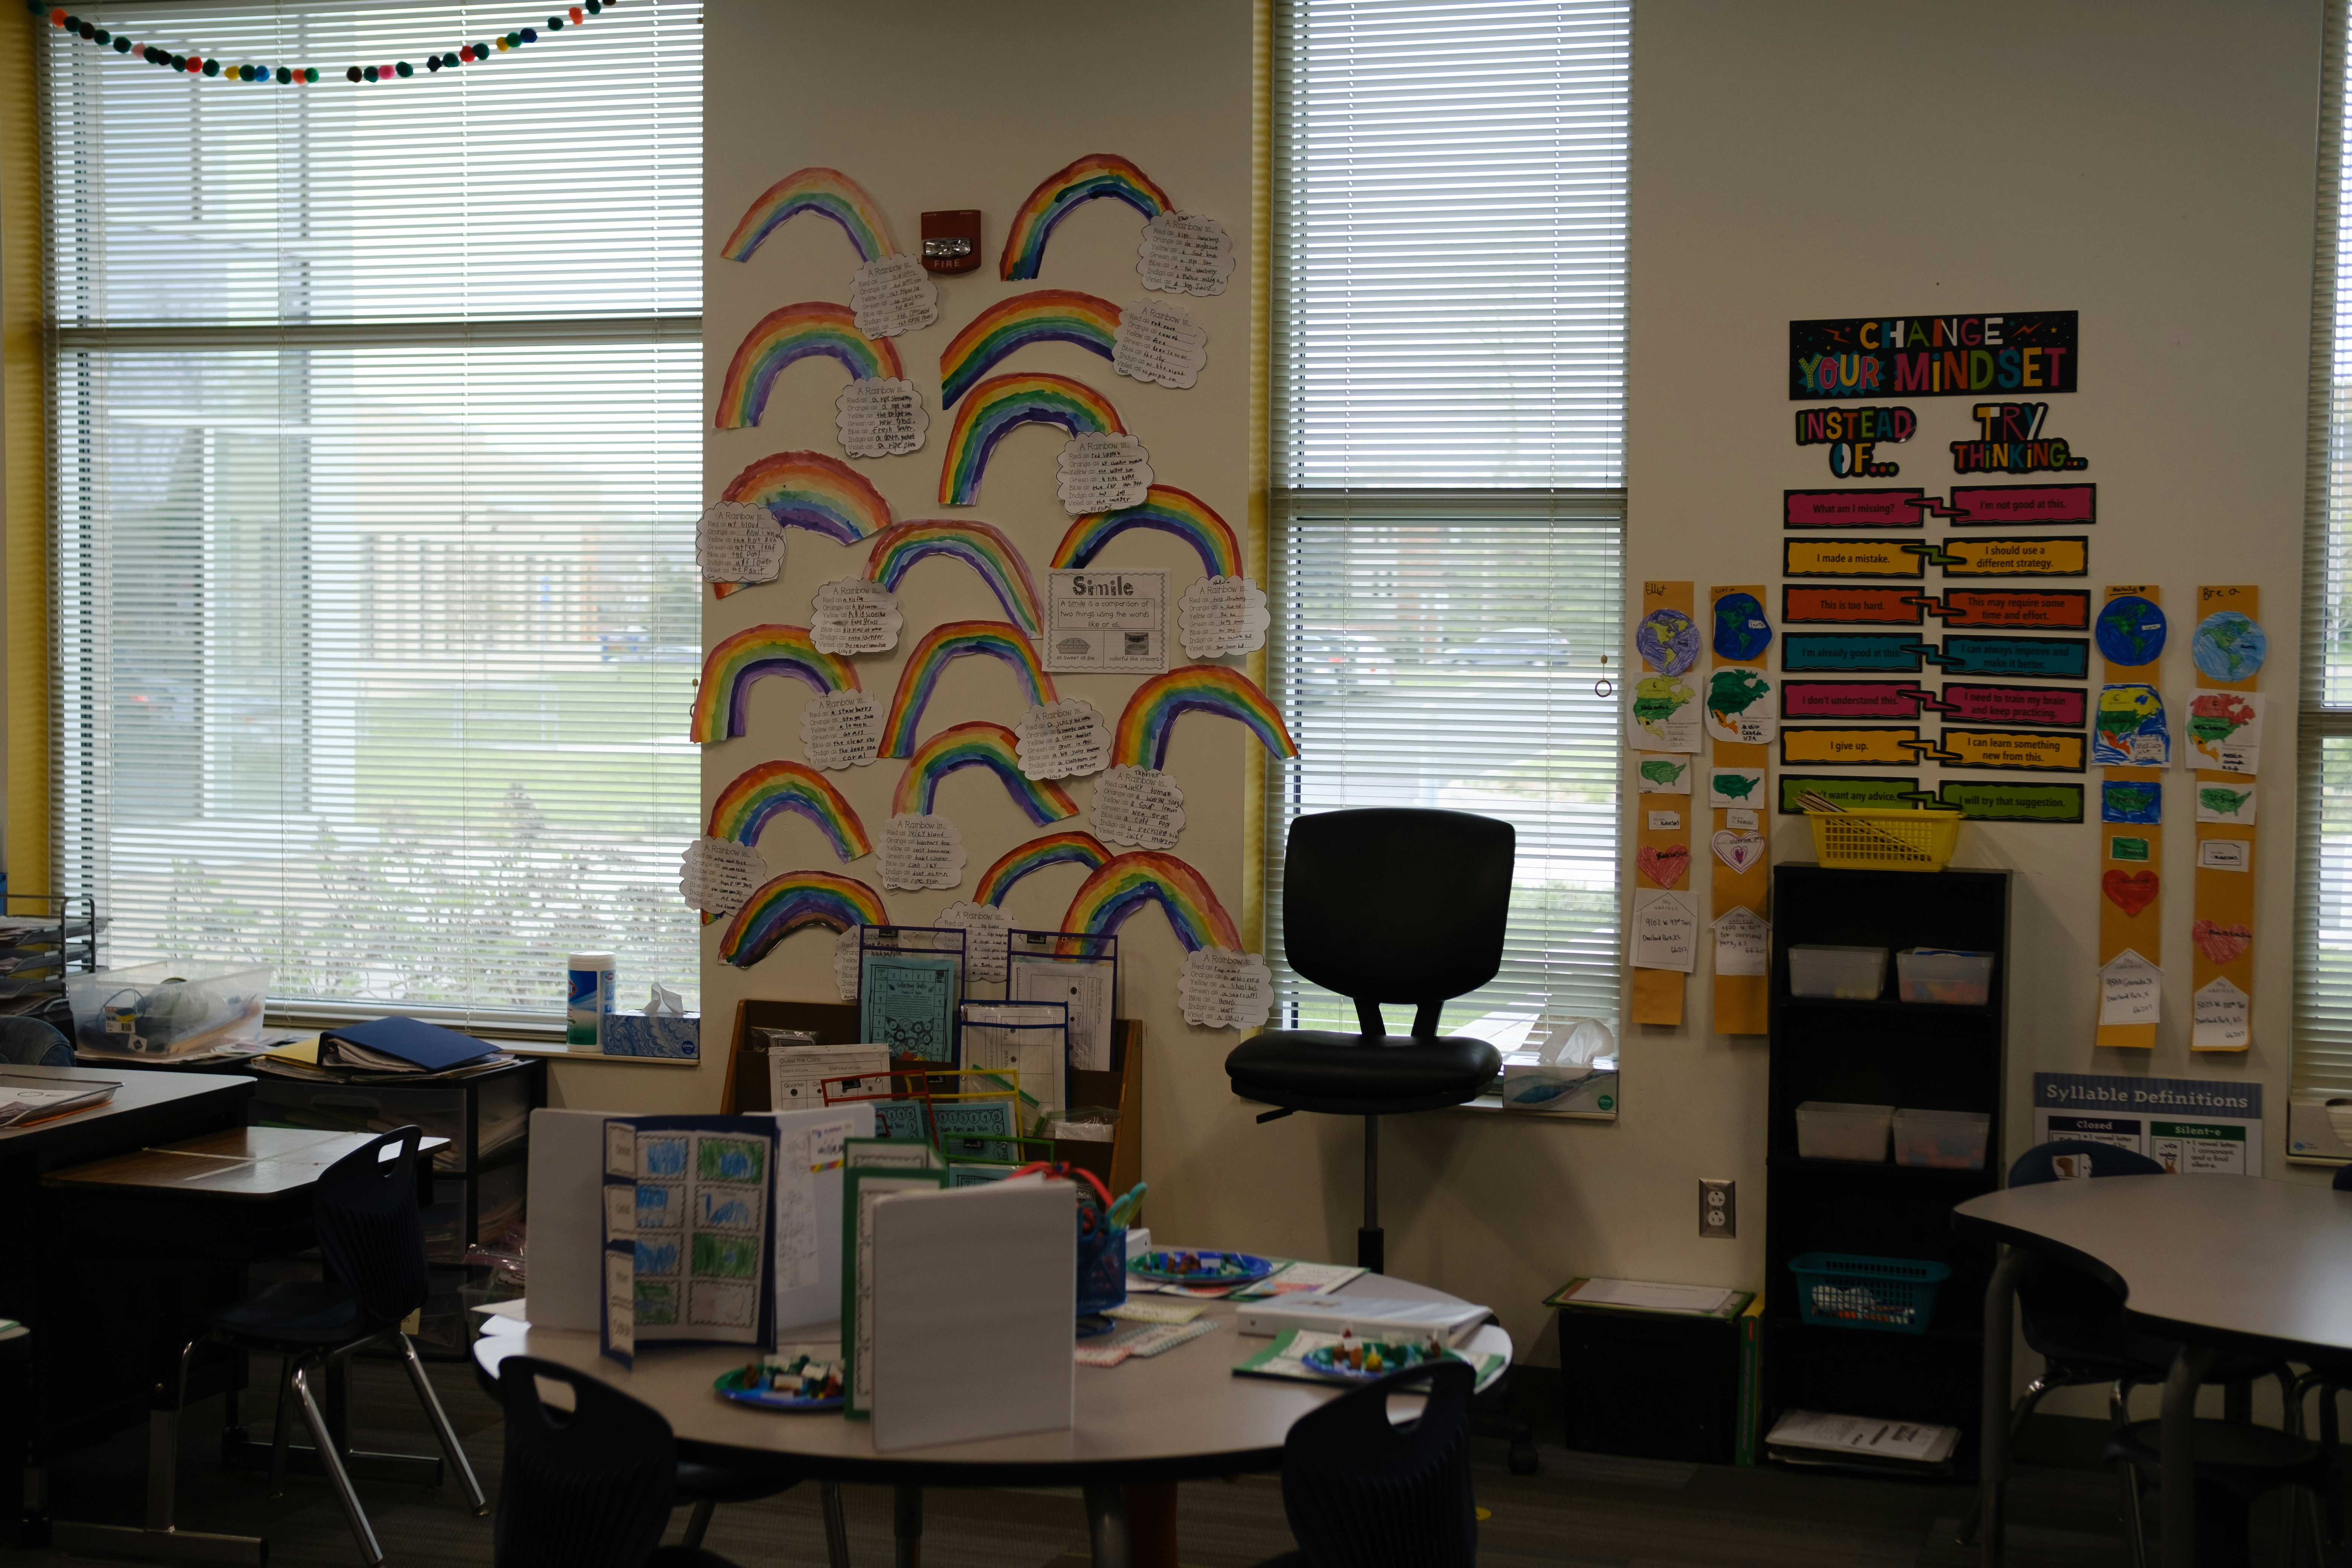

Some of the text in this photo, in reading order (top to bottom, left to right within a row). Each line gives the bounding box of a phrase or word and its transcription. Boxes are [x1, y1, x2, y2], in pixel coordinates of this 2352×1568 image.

[934, 259, 960, 268] FIRE
[1860, 317, 2003, 349] CHANGE
[1799, 354, 1880, 389] YOUR
[1800, 410, 1911, 441] INSTEAD
[1977, 406, 2044, 441] TRY
[1813, 504, 1835, 513] What
[1853, 504, 1855, 513] I
[1858, 503, 1895, 515] missing?
[1980, 501, 1994, 509] I'm
[2012, 499, 2035, 511] good
[2047, 499, 2066, 508] this.
[1986, 546, 1988, 555] I
[1991, 545, 2020, 555] should
[1817, 554, 1820, 562] I
[1822, 553, 1846, 563] made
[1855, 554, 1890, 563] mistake.
[1977, 558, 2053, 570] different strategy.
[1072, 576, 1134, 596] Simile
[1820, 600, 1885, 610] This is too hard.
[1968, 597, 1985, 606] This
[1987, 600, 2006, 609] may
[2008, 598, 2039, 609] require
[1982, 610, 2049, 620] time and effort.
[1802, 647, 1902, 660] I'm already good at this.
[1962, 644, 1965, 652] I
[1984, 645, 2012, 657] always
[2015, 646, 2050, 657] improve
[2052, 647, 2069, 656] and
[1983, 658, 2046, 669] make it better.
[1802, 695, 1899, 705] I don't understand this.
[1965, 692, 2066, 706] I need to train my brain
[1971, 706, 2058, 720] and keep practicing.
[1831, 741, 1869, 753] I give up.
[1968, 737, 1971, 746] I
[1990, 738, 2012, 748] learn
[2014, 740, 2060, 752] something
[2003, 751, 2023, 761] from
[2025, 752, 2044, 762] this.
[1125, 774, 1156, 786] Rainbow
[1851, 793, 1866, 802] any
[1868, 792, 1897, 801] advice.
[1959, 795, 2066, 809] I will try that suggestion.
[905, 821, 934, 829] Rainbow
[897, 982, 914, 991] Collecting
[2047, 1085, 2248, 1107] Syllable Definitions
[2076, 1121, 2113, 1130] Closed
[2175, 1126, 2221, 1136] Silent-e
